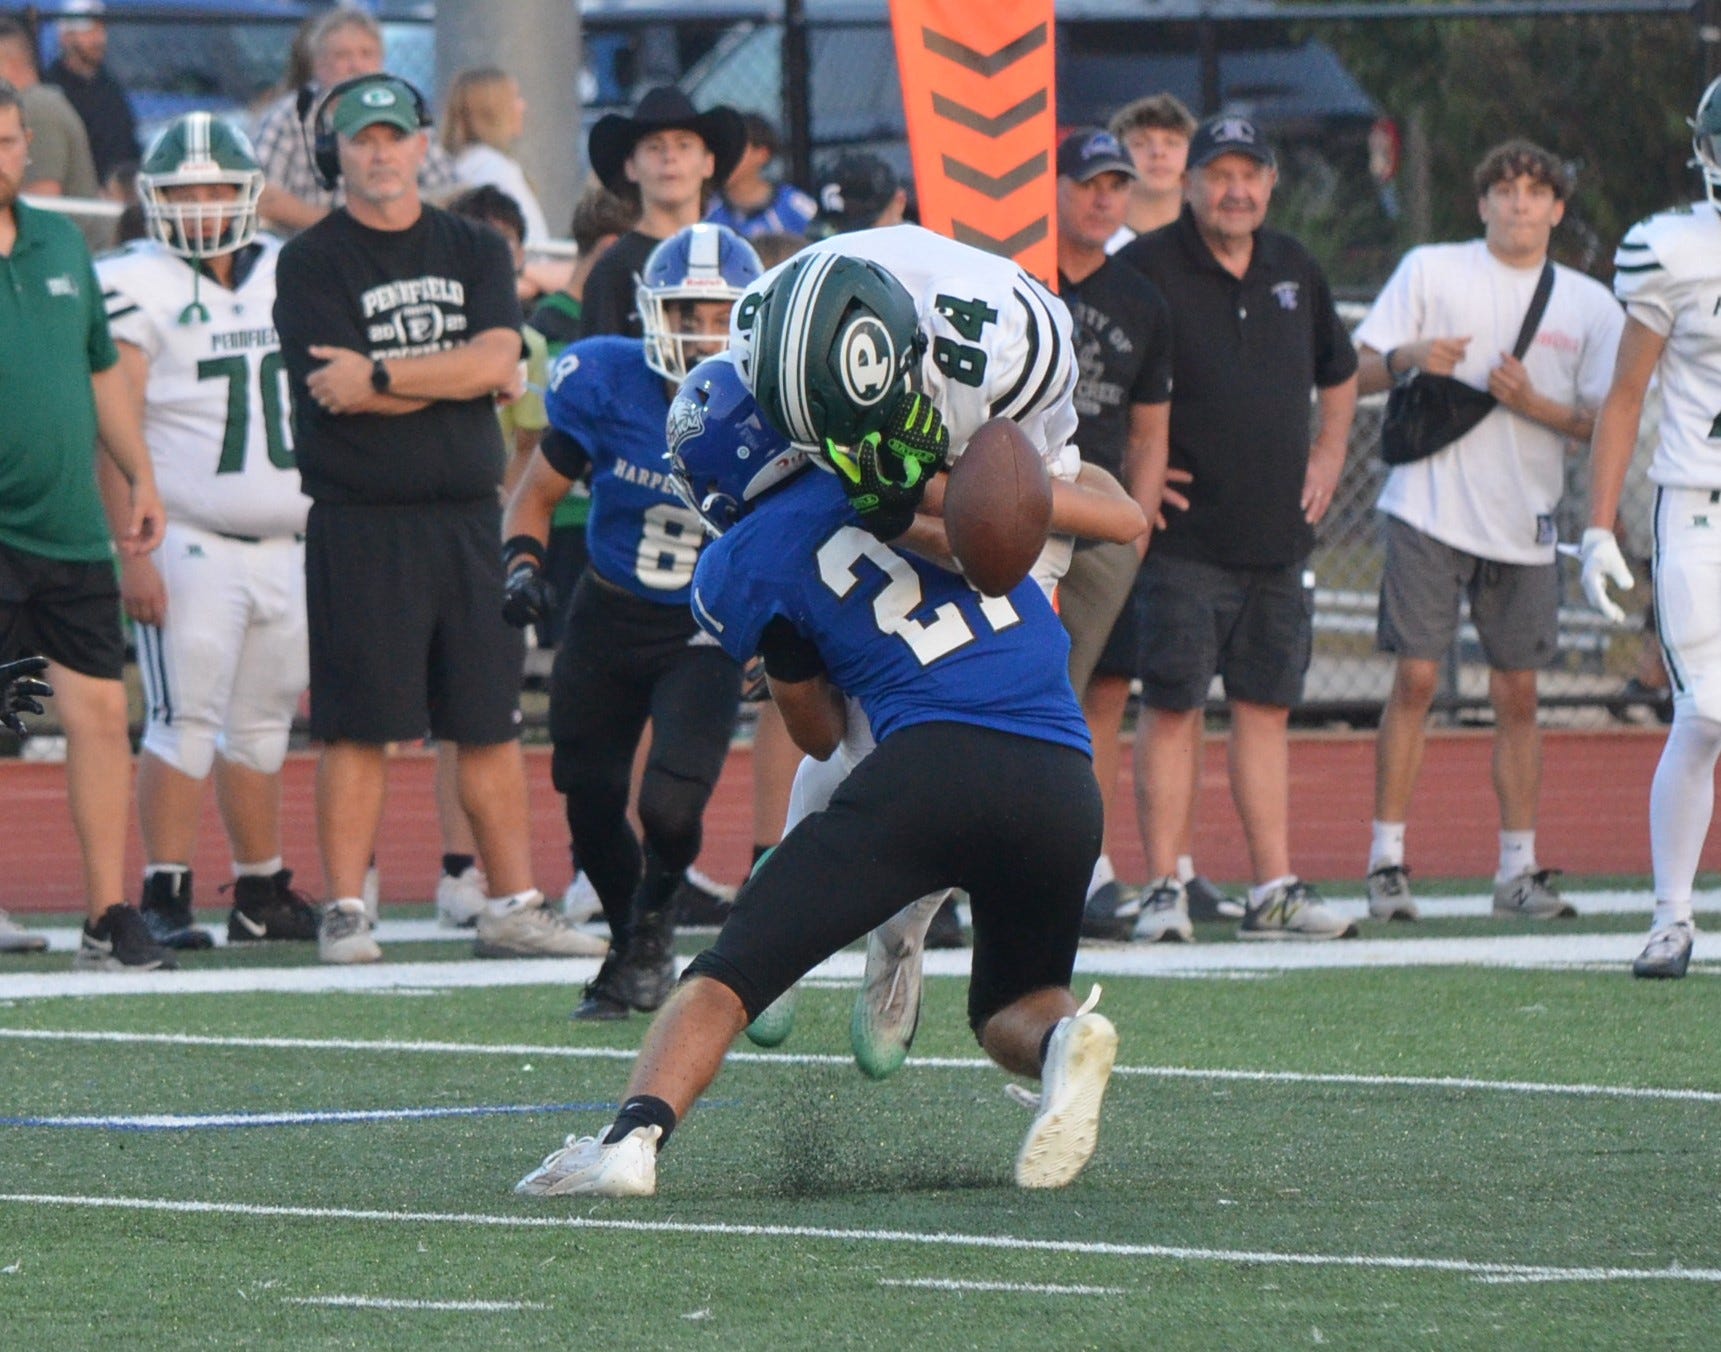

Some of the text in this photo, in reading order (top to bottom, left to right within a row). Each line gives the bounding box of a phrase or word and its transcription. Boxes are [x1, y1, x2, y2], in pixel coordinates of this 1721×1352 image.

[933, 294, 998, 388] 84
[197, 352, 300, 475] 70
[636, 503, 705, 591] 8
